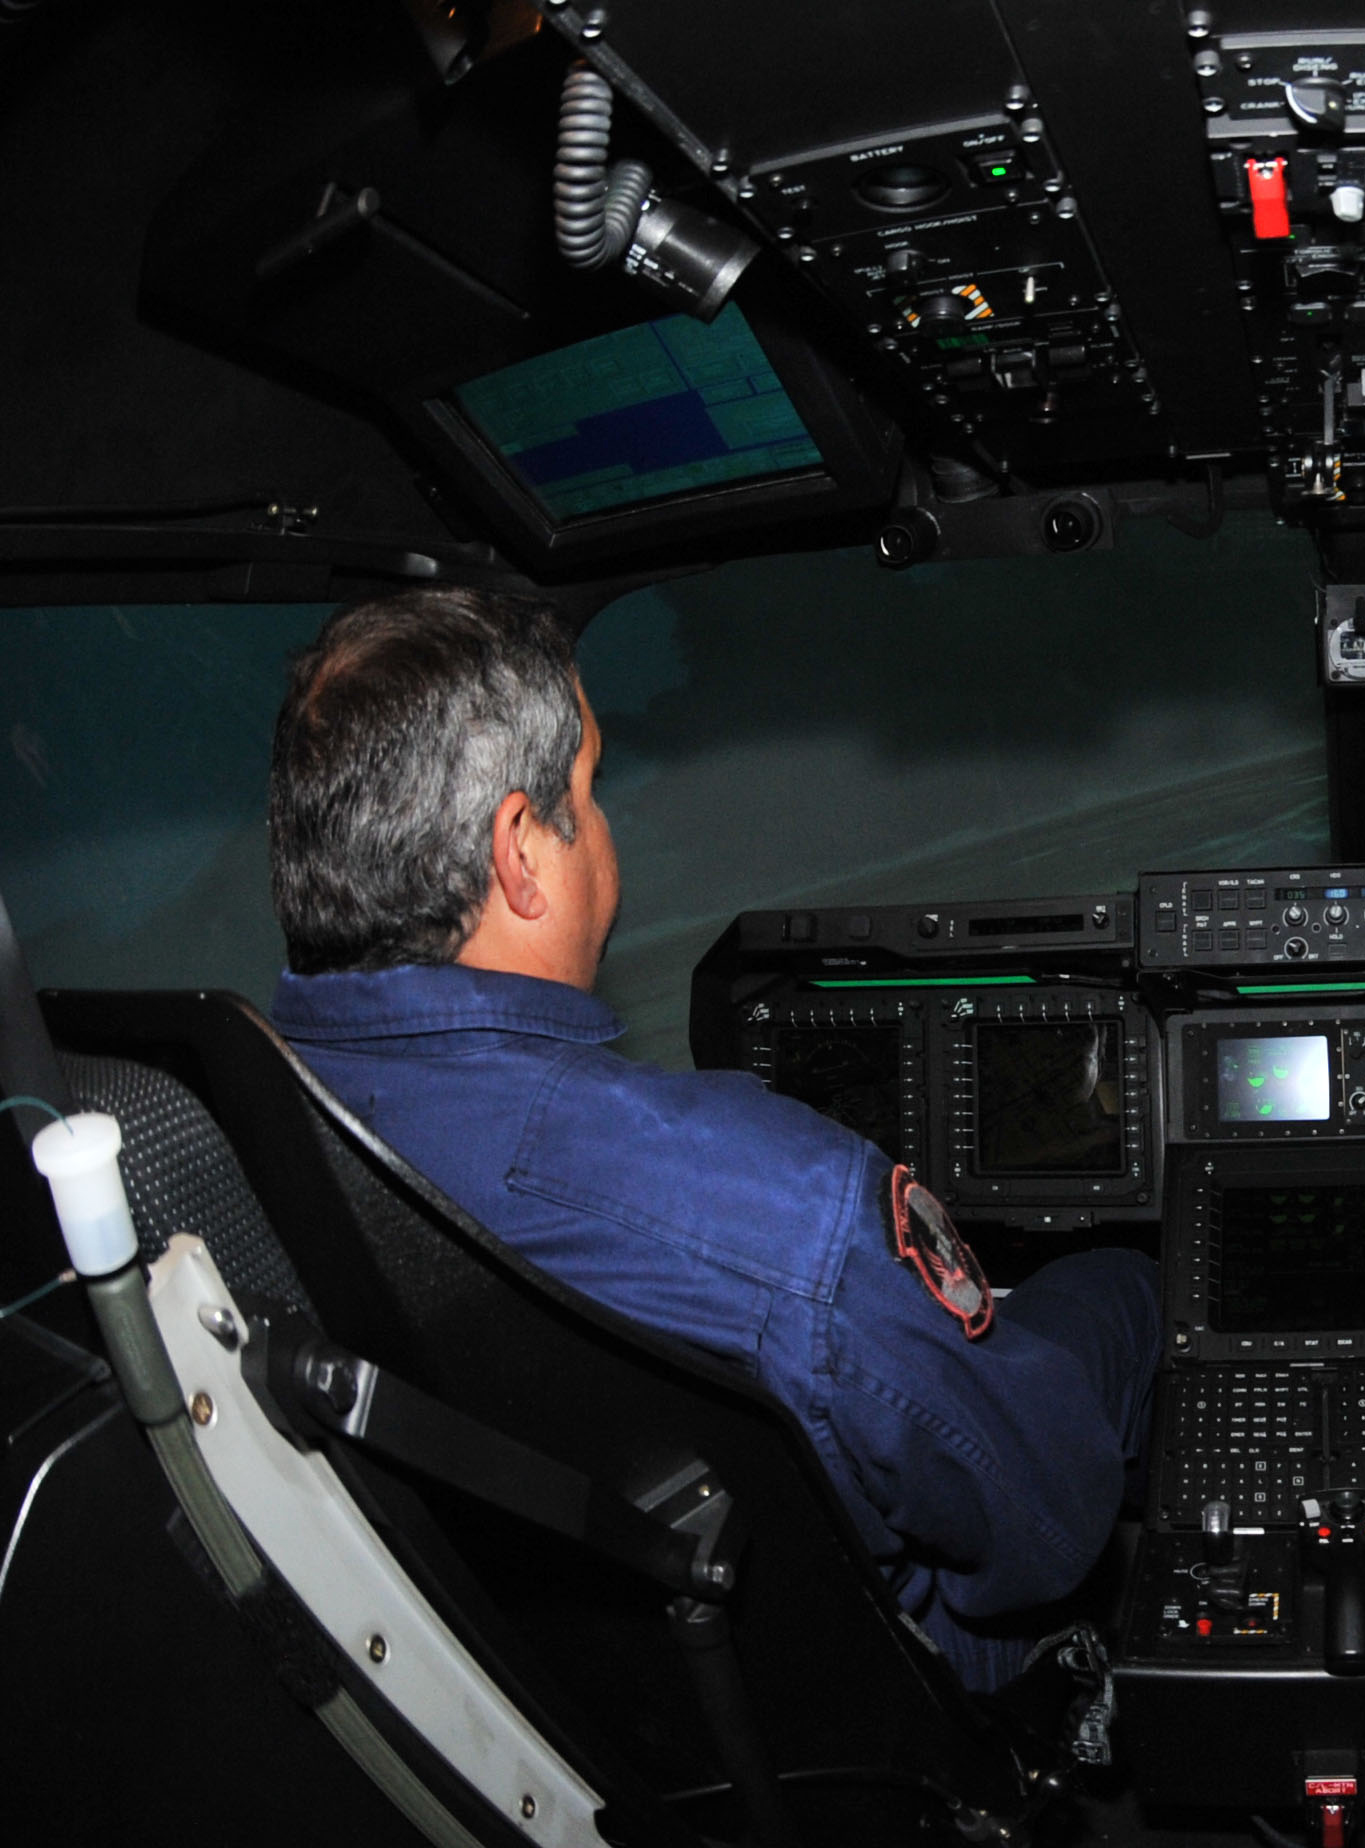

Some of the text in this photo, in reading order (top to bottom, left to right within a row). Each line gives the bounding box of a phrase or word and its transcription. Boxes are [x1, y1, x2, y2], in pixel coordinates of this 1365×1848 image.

[1248, 78, 1280, 86] STOP
[1240, 101, 1280, 109] CRANK
[850, 145, 904, 162] BATTERY
